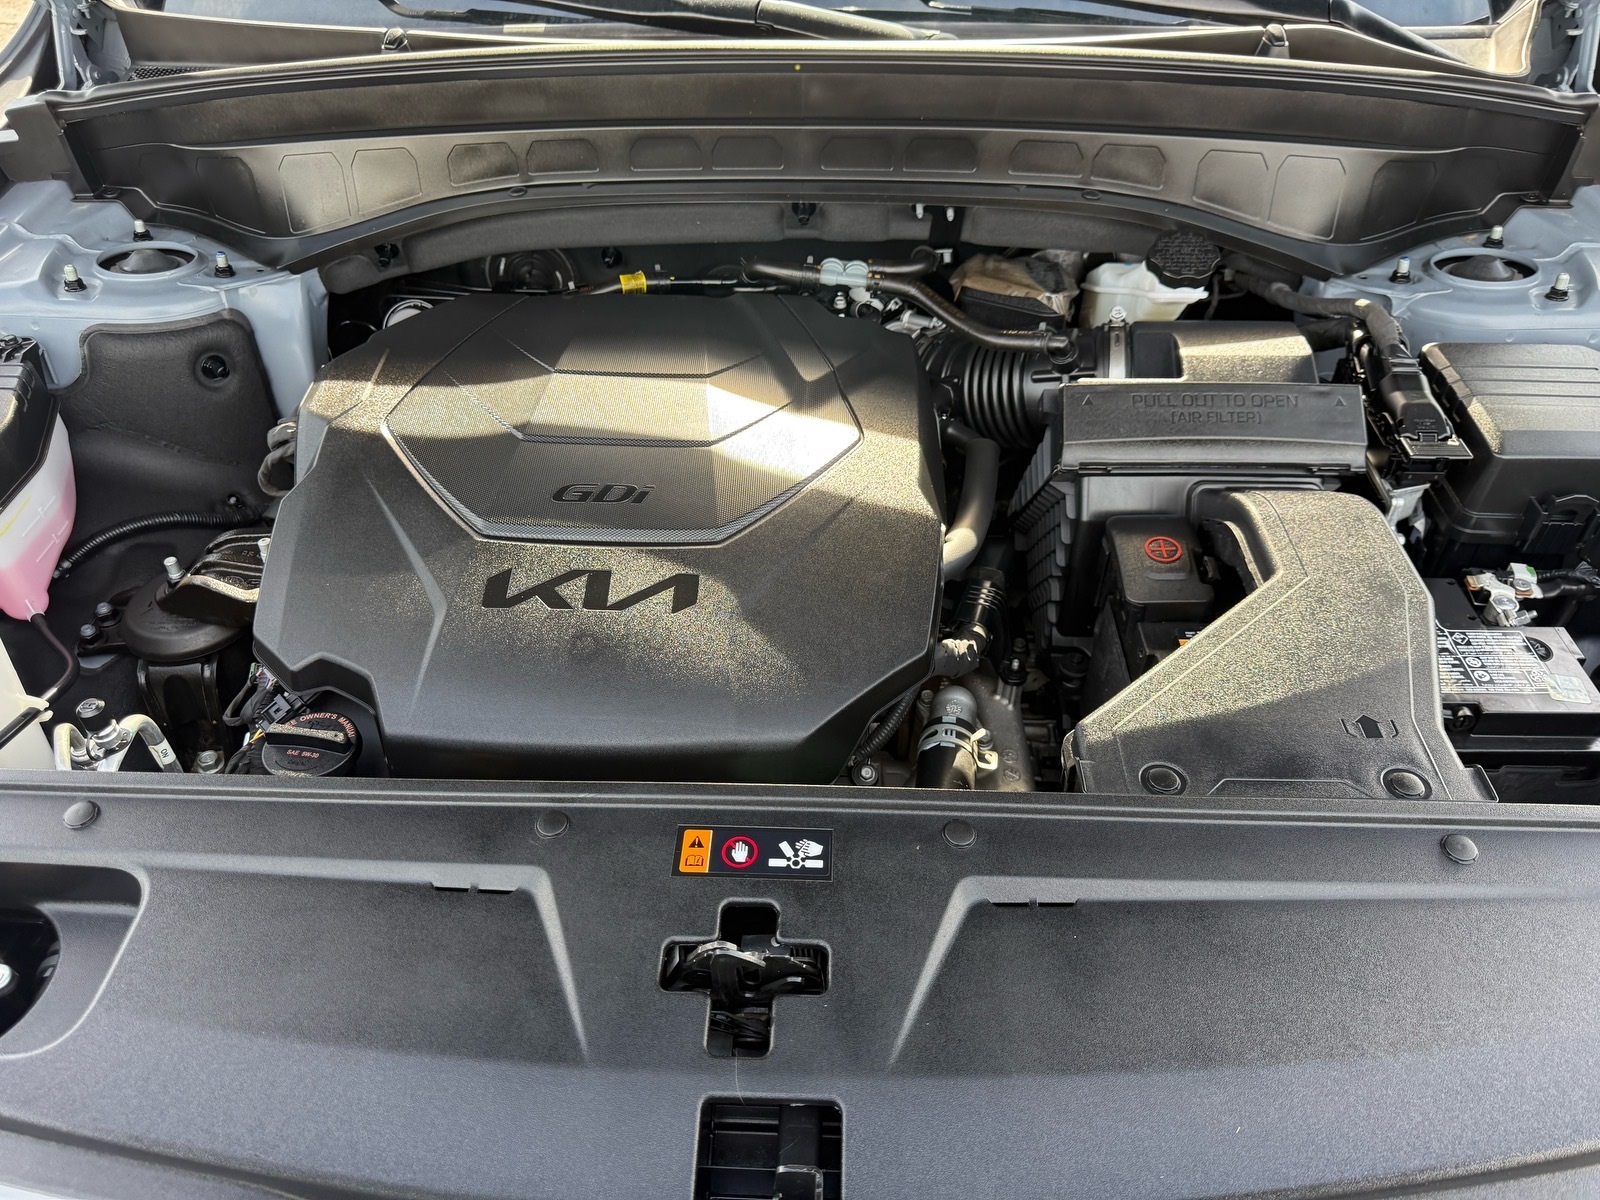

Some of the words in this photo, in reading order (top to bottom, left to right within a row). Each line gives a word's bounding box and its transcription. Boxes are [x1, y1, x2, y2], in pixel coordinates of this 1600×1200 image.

[1131, 393, 1177, 407] PULL
[1182, 393, 1217, 408] OUT
[1221, 393, 1246, 408] TO
[1251, 393, 1299, 408] OPEN
[552, 483, 656, 504] GDi
[482, 568, 700, 614] KIA
[300, 712, 338, 722] OWNER'S
